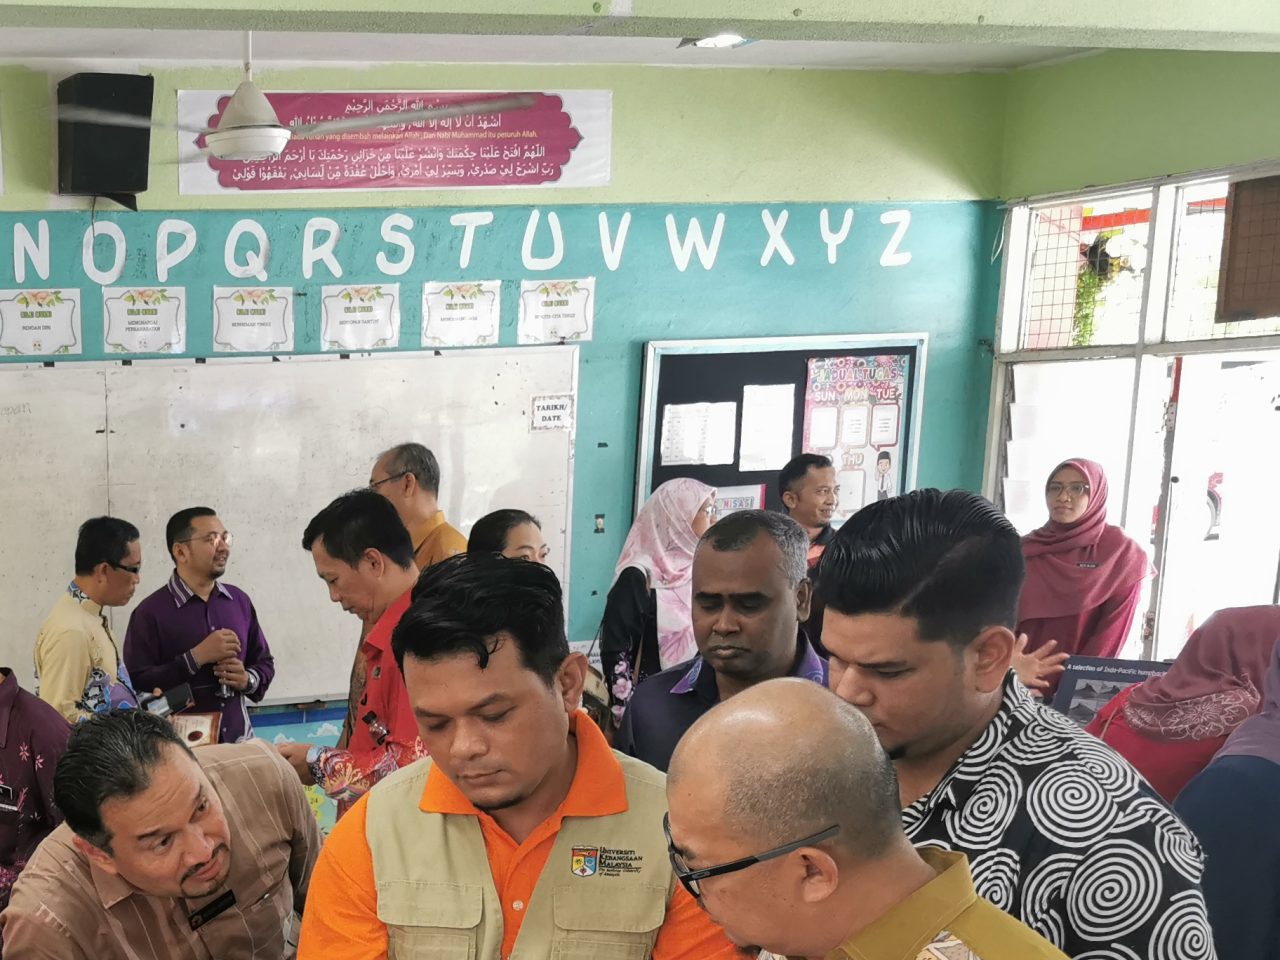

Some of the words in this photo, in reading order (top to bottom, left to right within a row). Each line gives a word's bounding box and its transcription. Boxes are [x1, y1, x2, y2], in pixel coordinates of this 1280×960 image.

[14, 219, 49, 283] N
[82, 220, 126, 285] O
[156, 219, 197, 282] P
[224, 218, 270, 282] Q
[301, 216, 343, 280] R
[375, 211, 416, 277] S
[449, 211, 495, 271] T
[520, 207, 565, 272] U
[598, 211, 632, 272] V
[665, 212, 726, 273] W
[759, 208, 797, 267] X
[819, 208, 856, 266] Y
[879, 205, 914, 267] Z
[817, 367, 862, 382] JADUAL
[862, 367, 898, 381] TUGAS
[815, 390, 837, 401] SUN
[844, 387, 868, 401] MON
[876, 387, 896, 399] TUE
[536, 402, 568, 413] TARIKH/
[541, 413, 562, 423] DATE
[841, 452, 864, 465] THU
[1104, 667, 1137, 675] Indo-Pacific
